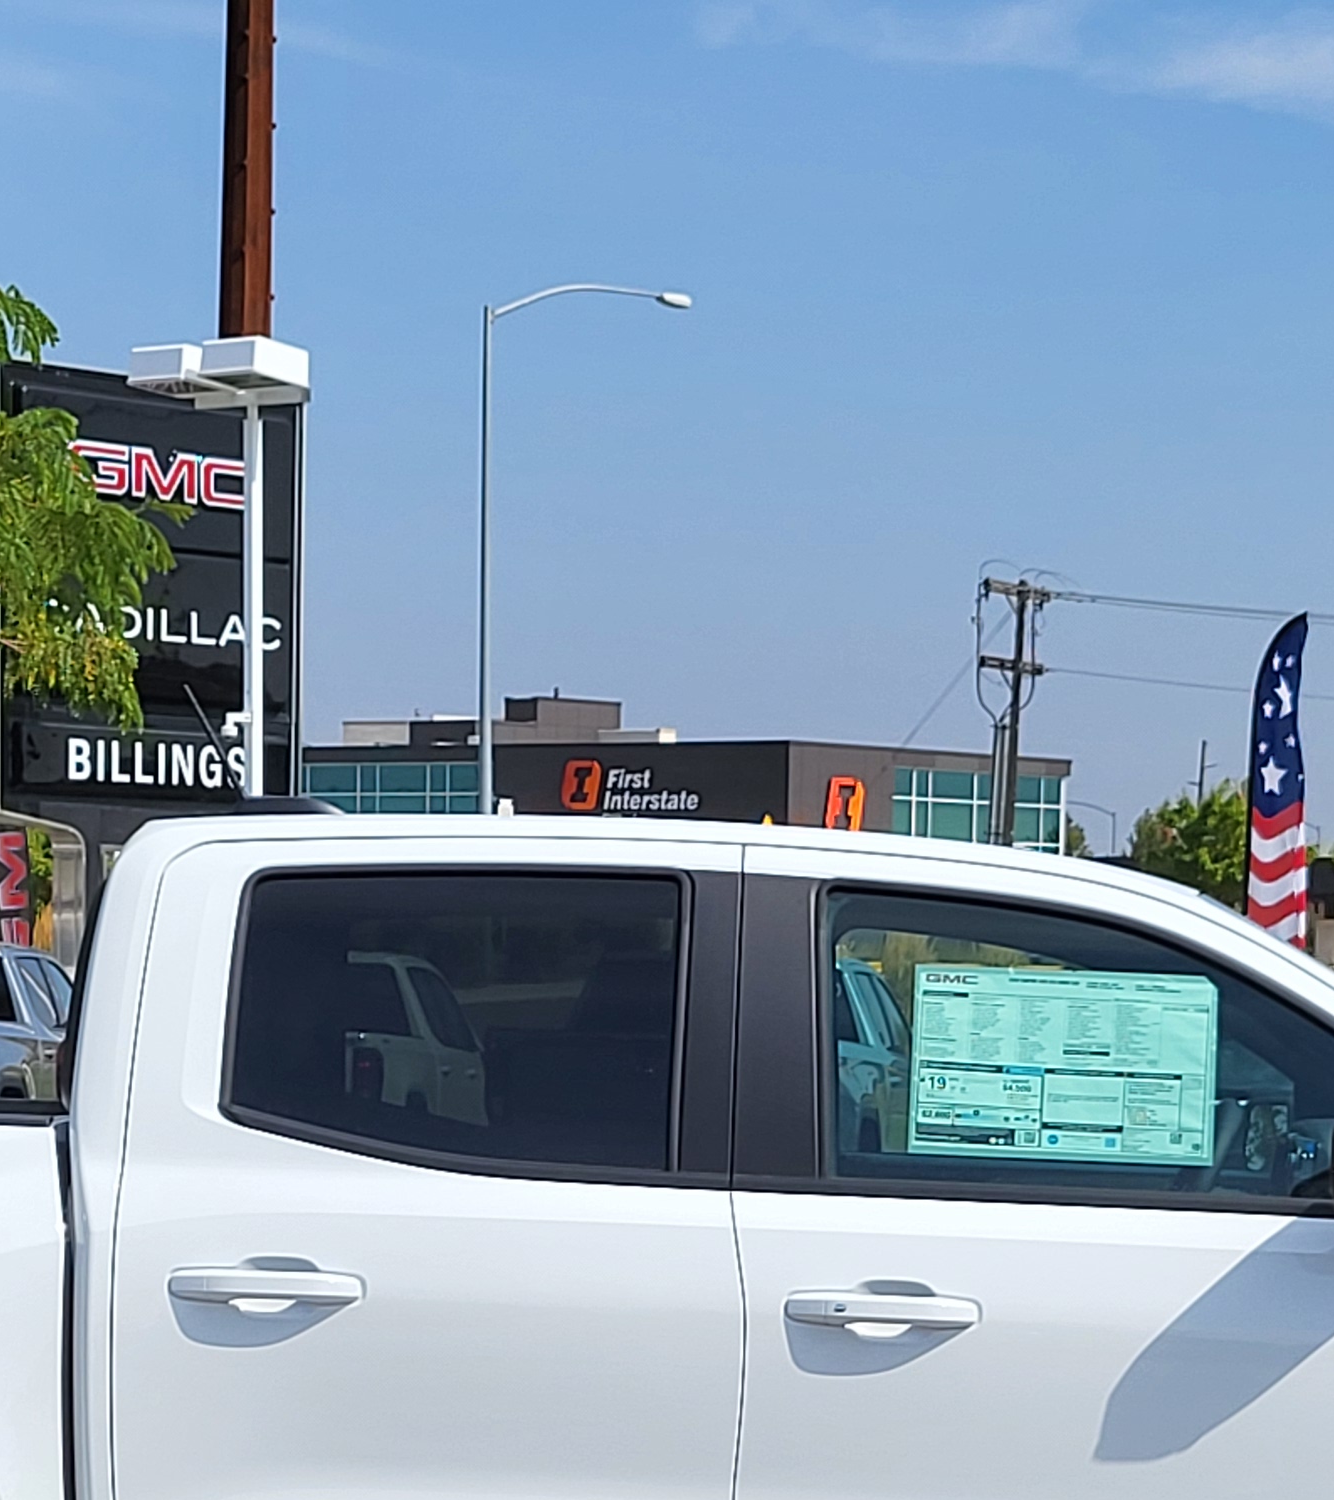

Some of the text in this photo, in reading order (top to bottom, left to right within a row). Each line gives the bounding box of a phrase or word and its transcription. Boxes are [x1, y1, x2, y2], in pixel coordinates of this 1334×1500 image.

[68, 440, 245, 510] GMC
[49, 599, 282, 650] ADILLAC
[68, 738, 245, 788] BILLINGS
[606, 768, 651, 789] First
[603, 790, 700, 811] Interstate
[926, 973, 979, 985] GMC
